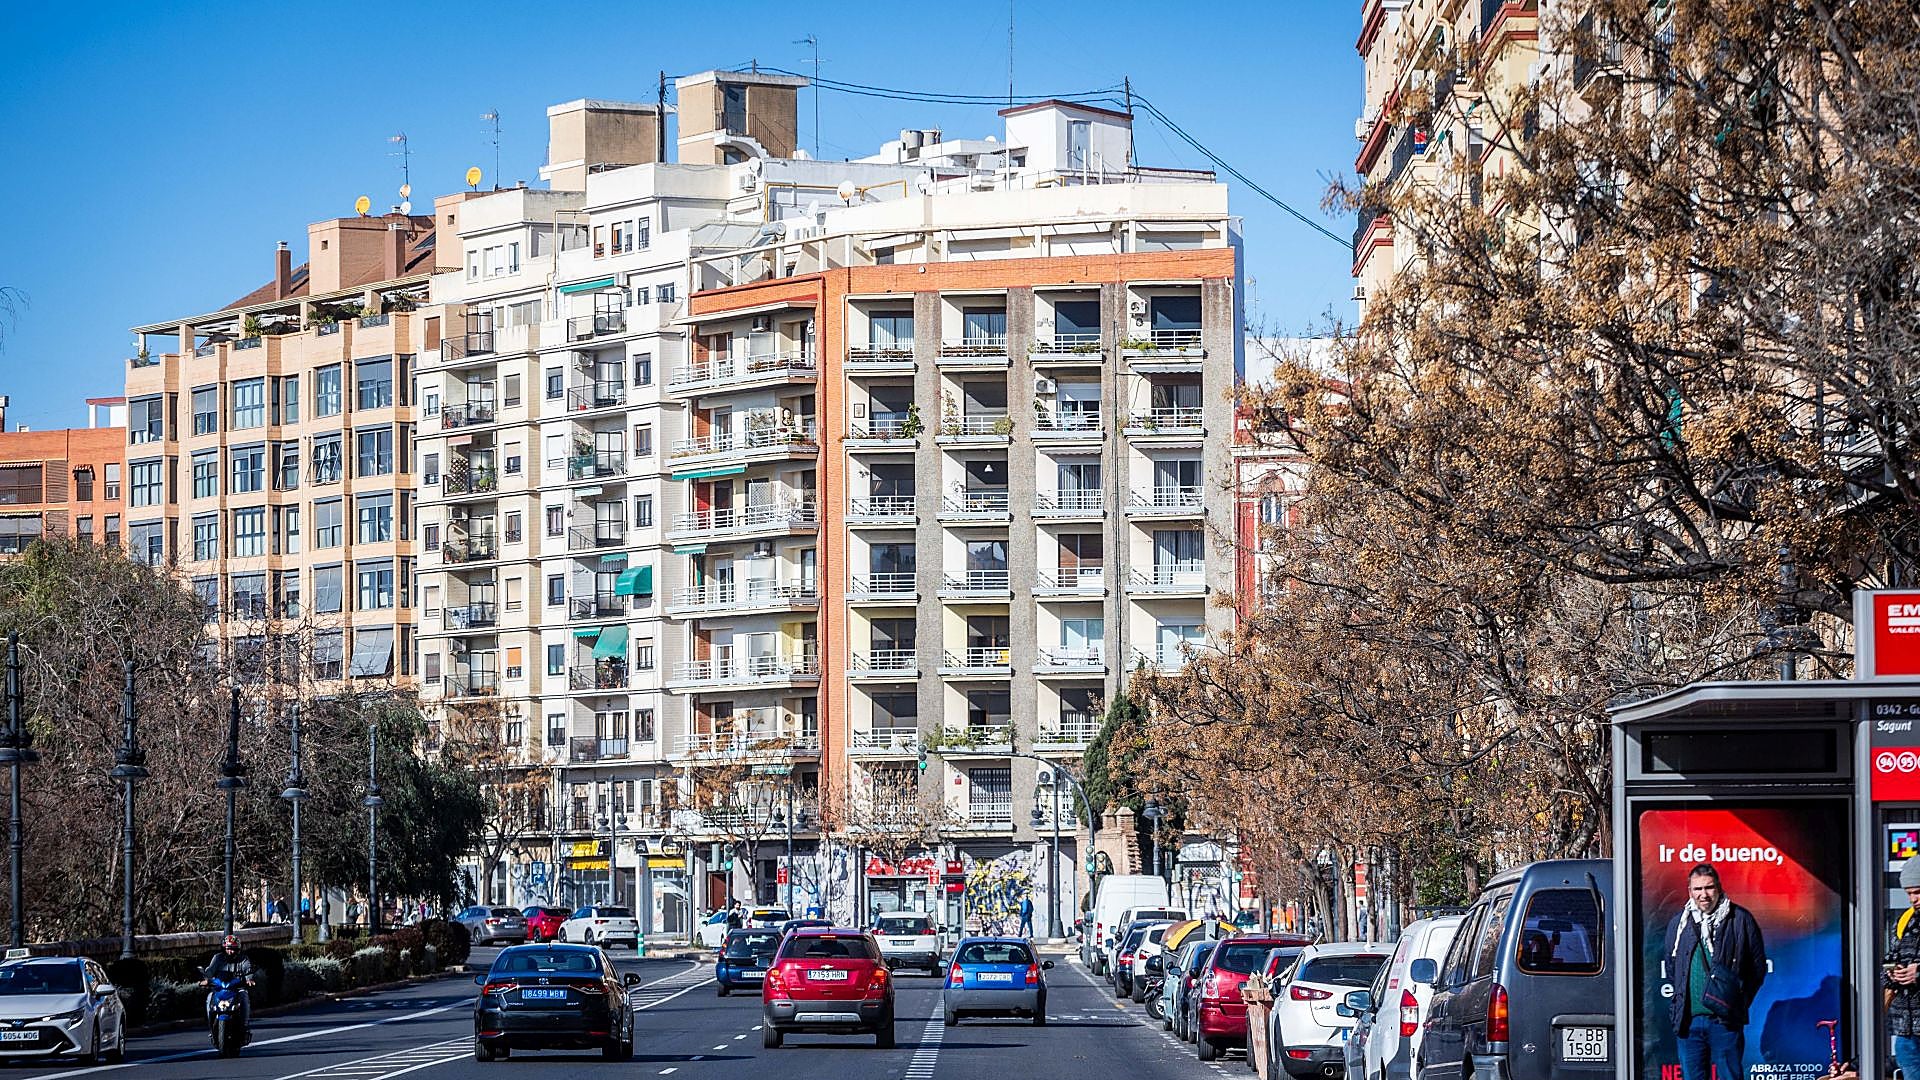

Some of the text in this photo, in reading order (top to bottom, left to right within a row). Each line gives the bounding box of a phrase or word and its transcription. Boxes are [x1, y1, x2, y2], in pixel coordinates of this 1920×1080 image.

[1876, 704, 1902, 714] 0342
[1877, 720, 1912, 733] Sagunt
[1880, 757, 1914, 768] 94 95
[1659, 843, 1783, 865] Ir de bueno,
[527, 990, 548, 998] 8499
[23, 1031, 38, 1039] MDG
[1567, 1029, 1604, 1041] Z BB
[1569, 1043, 1601, 1055] 1590
[1750, 1064, 1823, 1072] ABRAZA TODO
